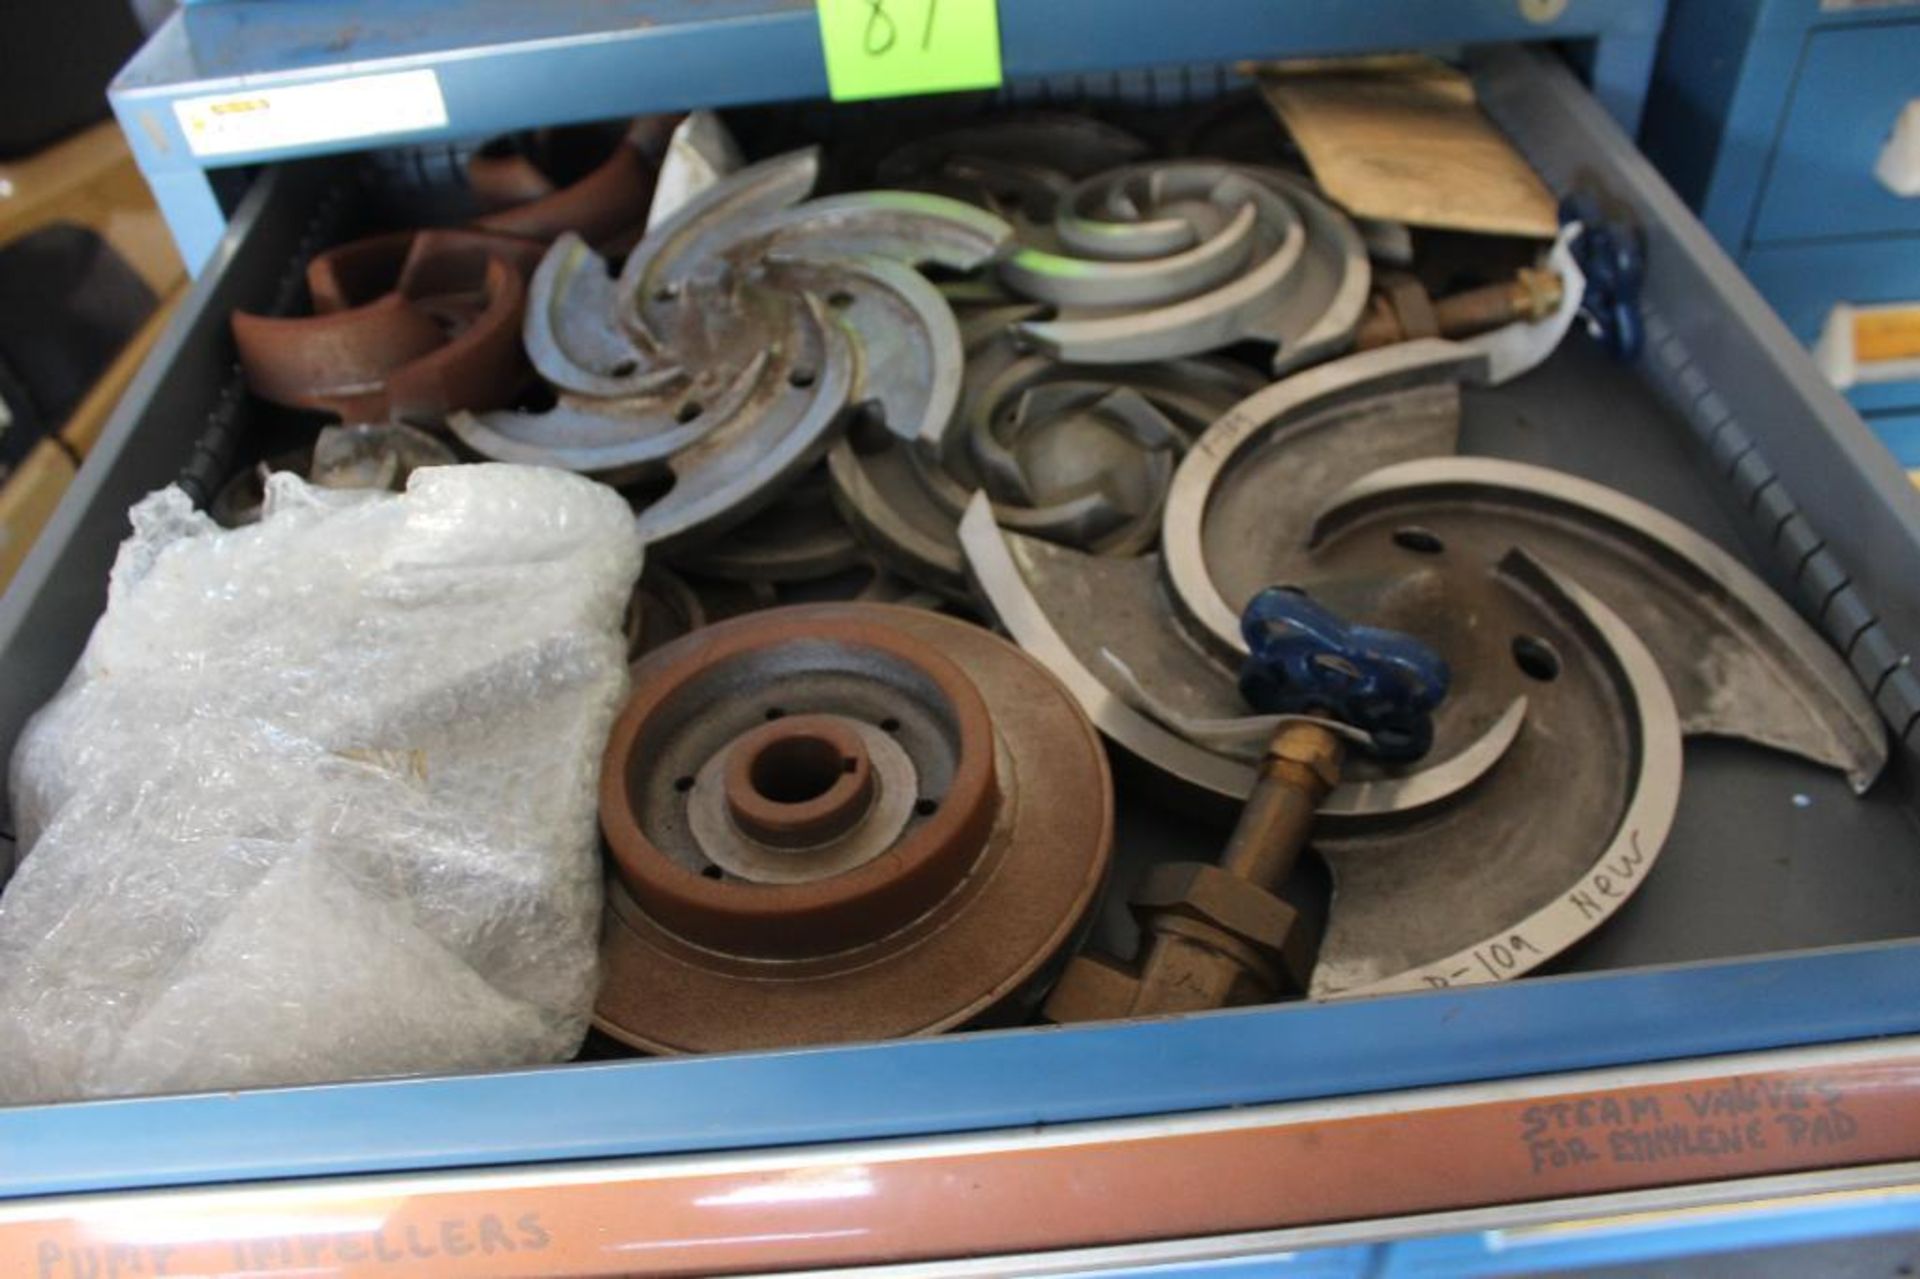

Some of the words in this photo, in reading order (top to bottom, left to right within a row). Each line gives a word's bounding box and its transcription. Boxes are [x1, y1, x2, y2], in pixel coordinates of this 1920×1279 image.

[1521, 1095, 1663, 1142] STEAM
[1528, 1136, 1600, 1176] FOR
[1774, 1107, 1859, 1147] PAD
